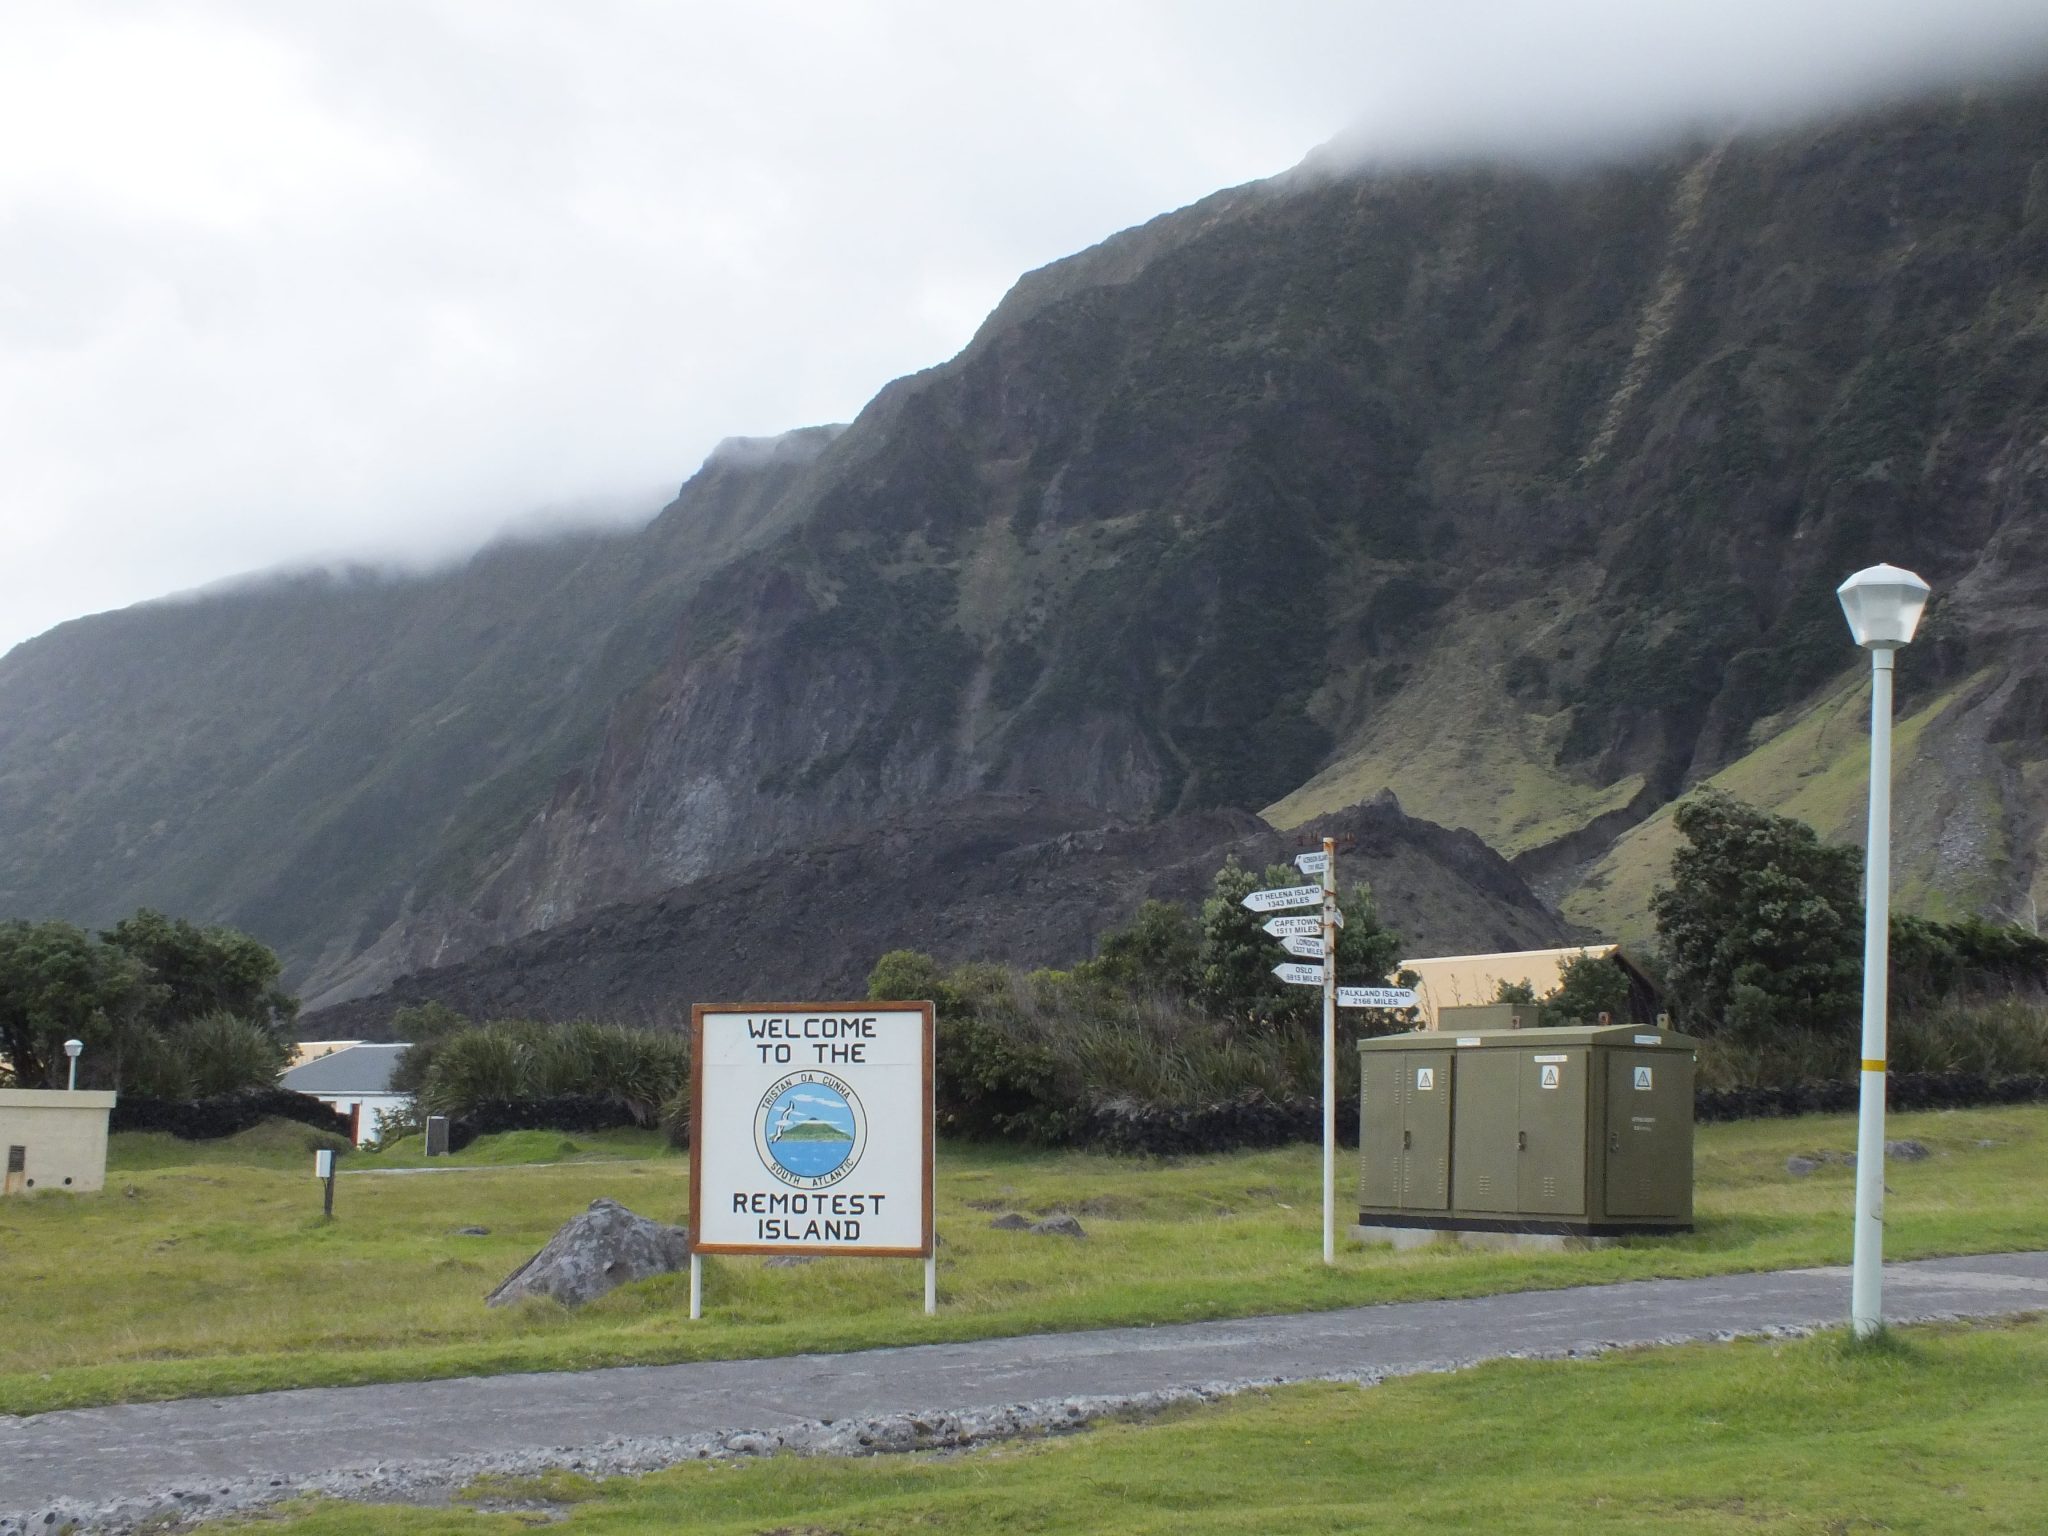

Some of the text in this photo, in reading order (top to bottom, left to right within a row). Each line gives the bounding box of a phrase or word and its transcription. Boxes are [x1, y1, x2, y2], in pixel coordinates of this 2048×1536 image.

[1265, 891, 1293, 899] HELENA
[1295, 887, 1319, 896] ISLAND
[1286, 896, 1309, 905] MILES
[1274, 918, 1319, 927] CAPE TOWN
[1296, 939, 1320, 948] LONDON
[1306, 948, 1324, 956] MILES
[1296, 966, 1313, 974] OSLO
[1302, 975, 1322, 983] MILES
[1339, 989, 1410, 998] FALKLAND ISLAND
[748, 1018, 877, 1038] WELCOME
[757, 1043, 866, 1063] TO THE
[762, 1074, 851, 1110] TRISTAN DA CUNHA
[771, 1158, 854, 1187] SOUTH ATLANTIC
[733, 1193, 885, 1215] REMOTEST
[759, 1219, 860, 1240] ISLAND
